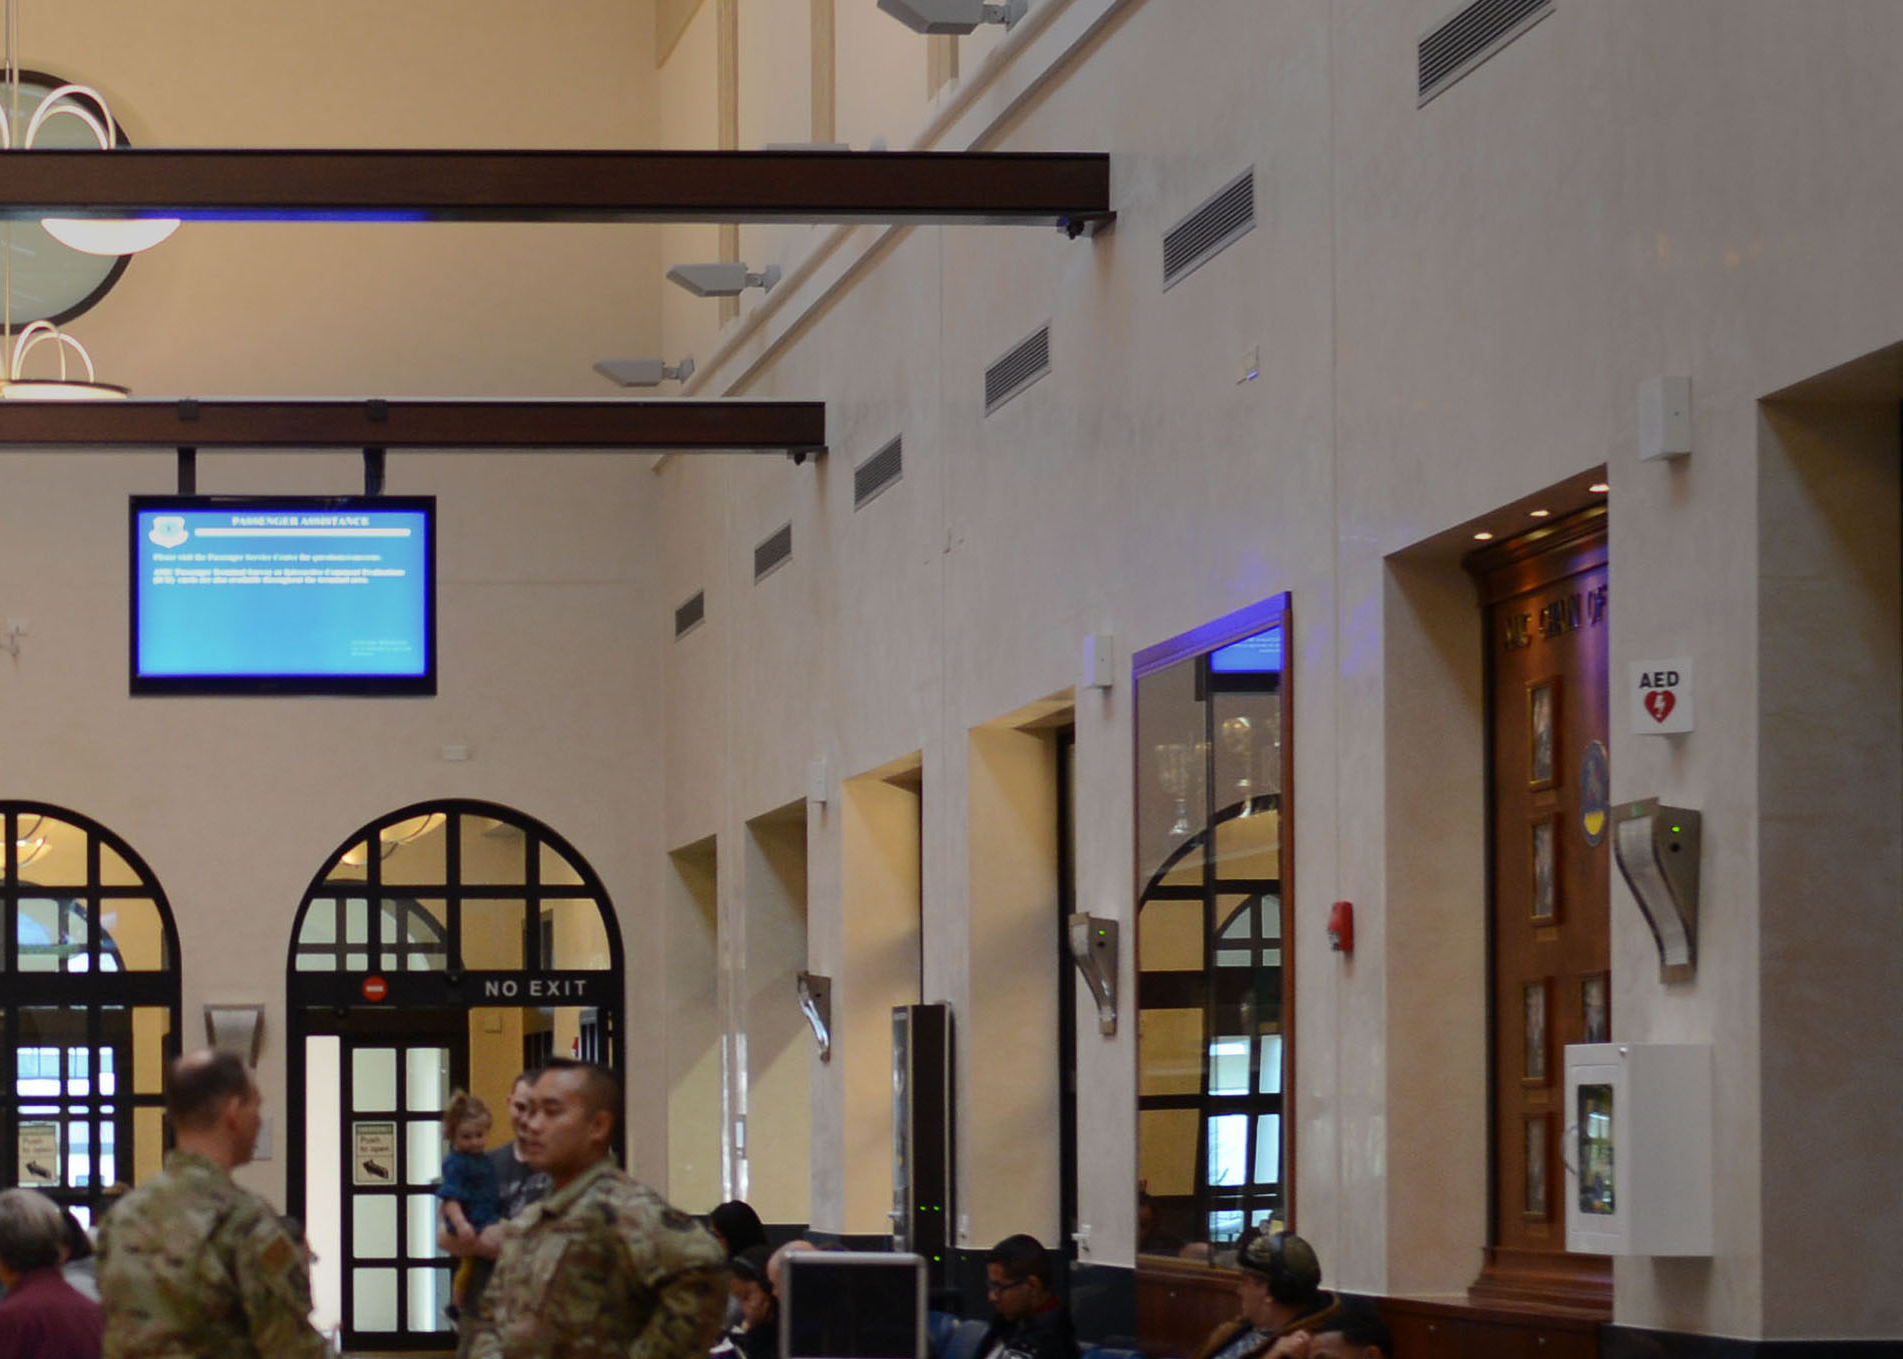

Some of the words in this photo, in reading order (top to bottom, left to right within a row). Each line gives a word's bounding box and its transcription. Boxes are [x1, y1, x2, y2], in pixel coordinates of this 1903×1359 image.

[1639, 671, 1680, 688] AED
[485, 981, 517, 997] NO
[529, 980, 587, 996] EXIT
